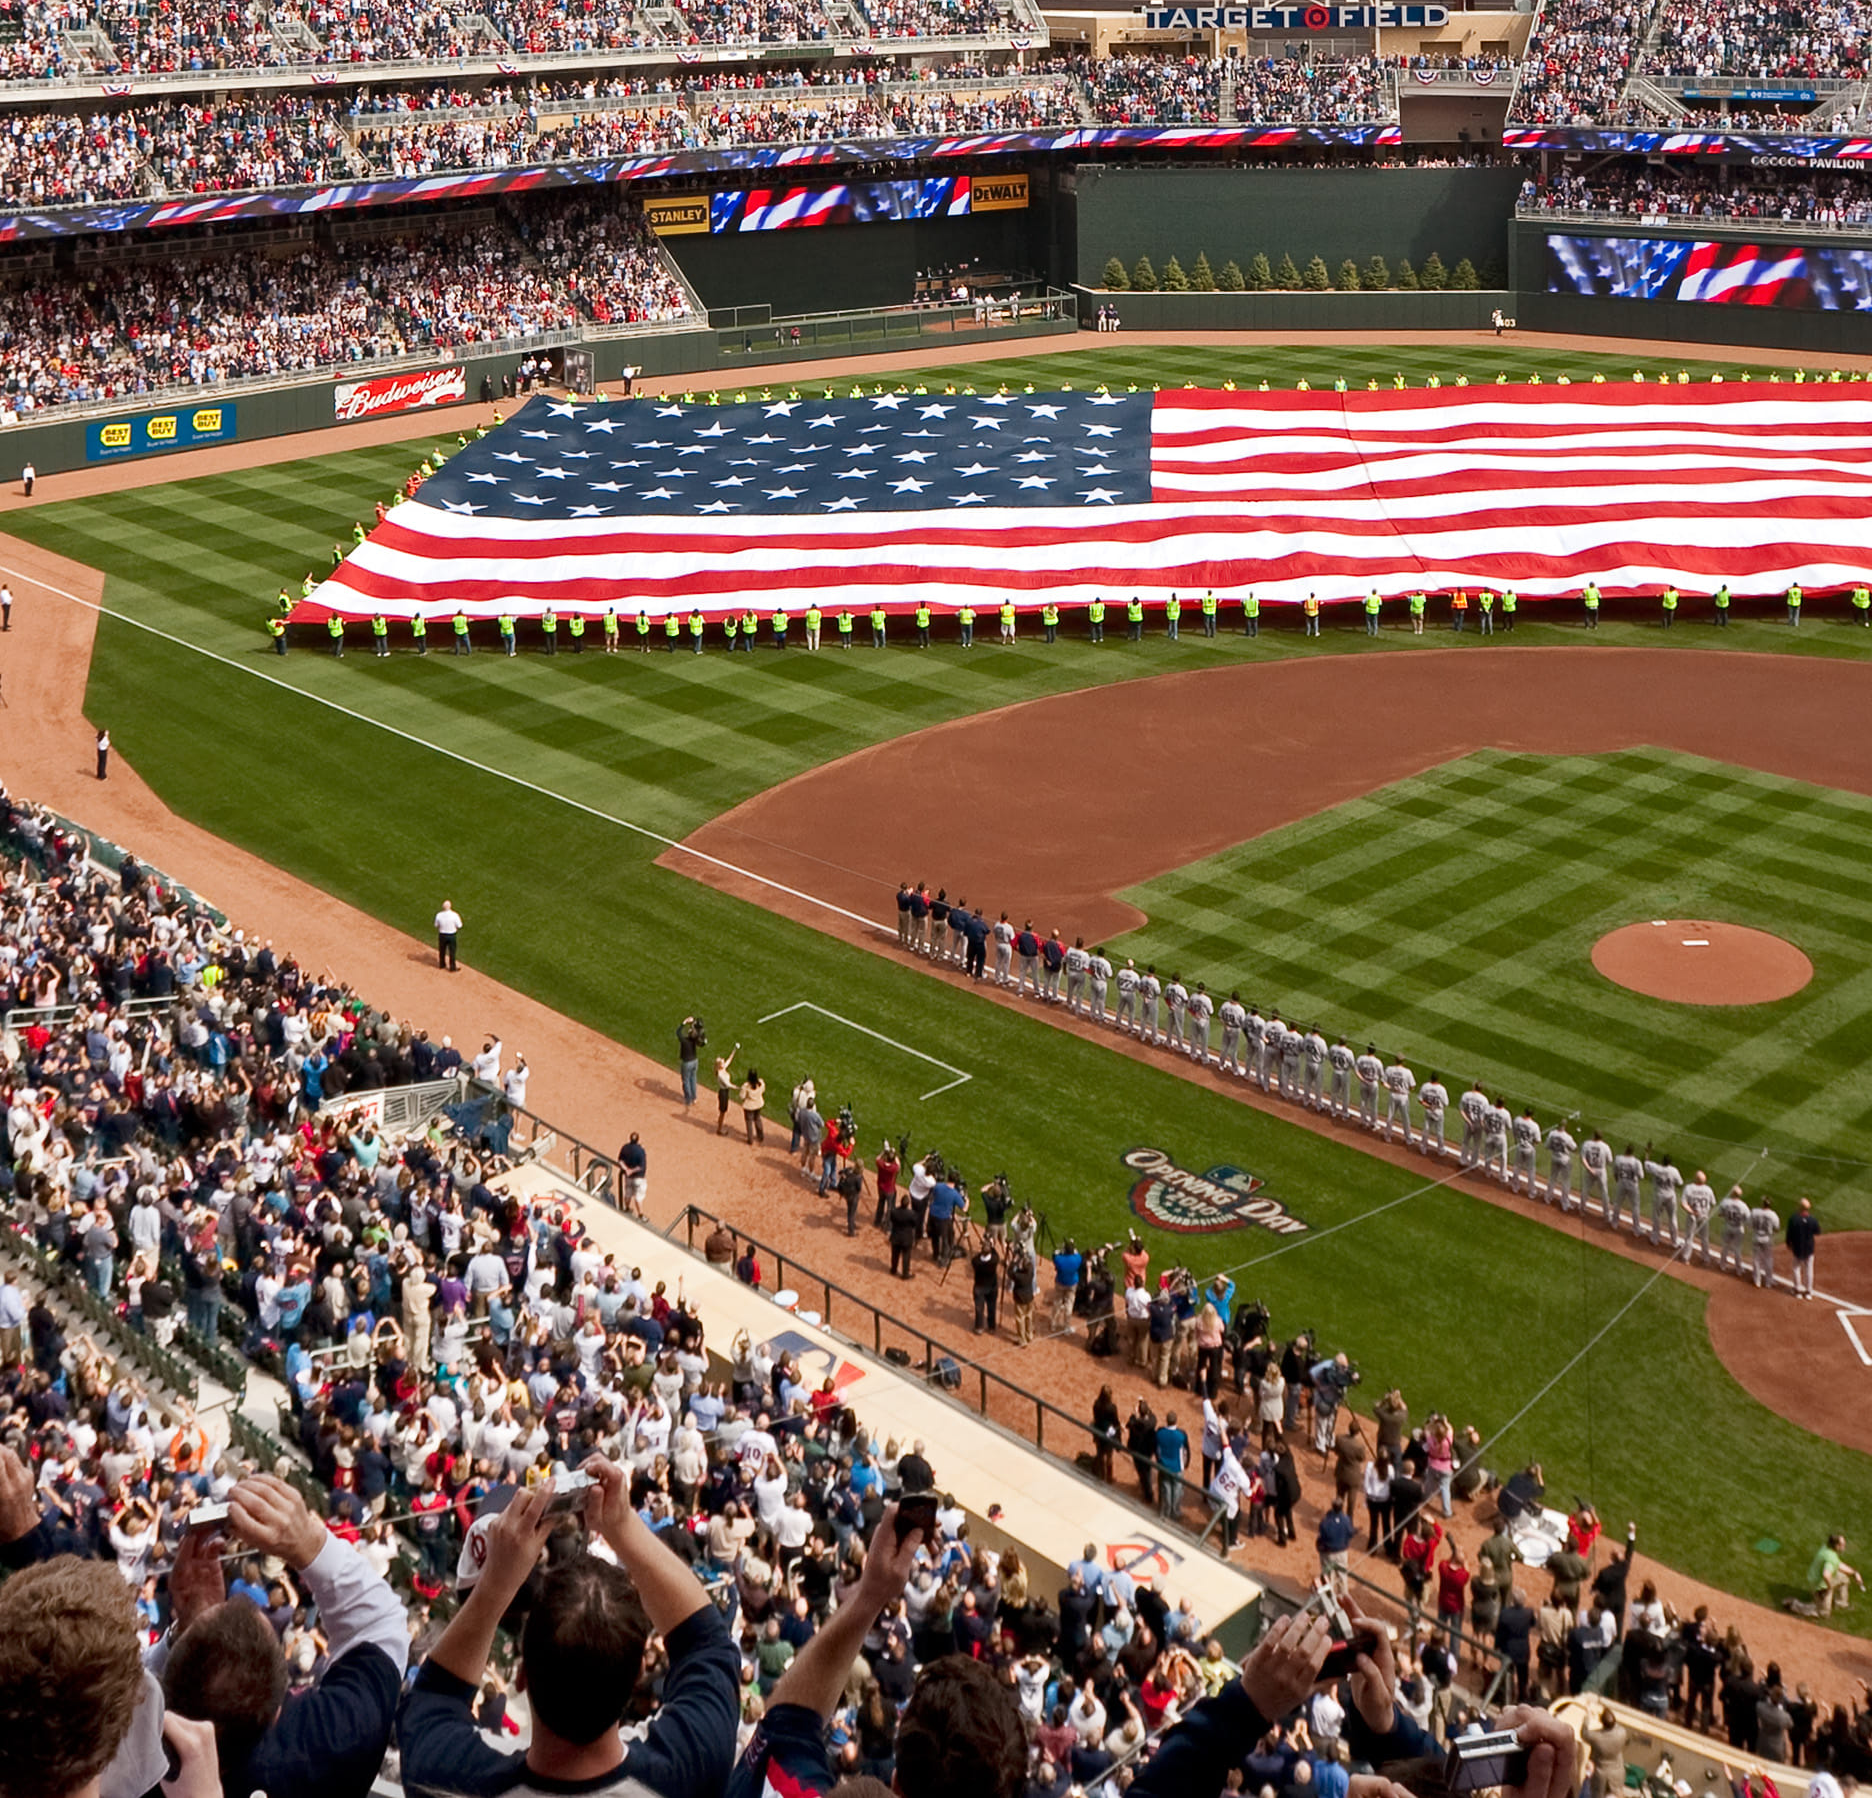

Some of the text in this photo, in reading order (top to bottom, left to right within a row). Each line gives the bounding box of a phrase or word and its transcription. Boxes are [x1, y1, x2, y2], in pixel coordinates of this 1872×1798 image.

[1150, 5, 1449, 29] TARGET FIELD
[1810, 157, 1865, 170] PAVILION
[650, 208, 703, 223] STANLEY
[336, 367, 458, 419] Budweiser
[151, 420, 175, 428] BEST
[197, 413, 220, 421] BEST
[198, 420, 217, 428] BUY
[1125, 1147, 1309, 1235] OPENING DAY
[1166, 1190, 1219, 1216] 2010
